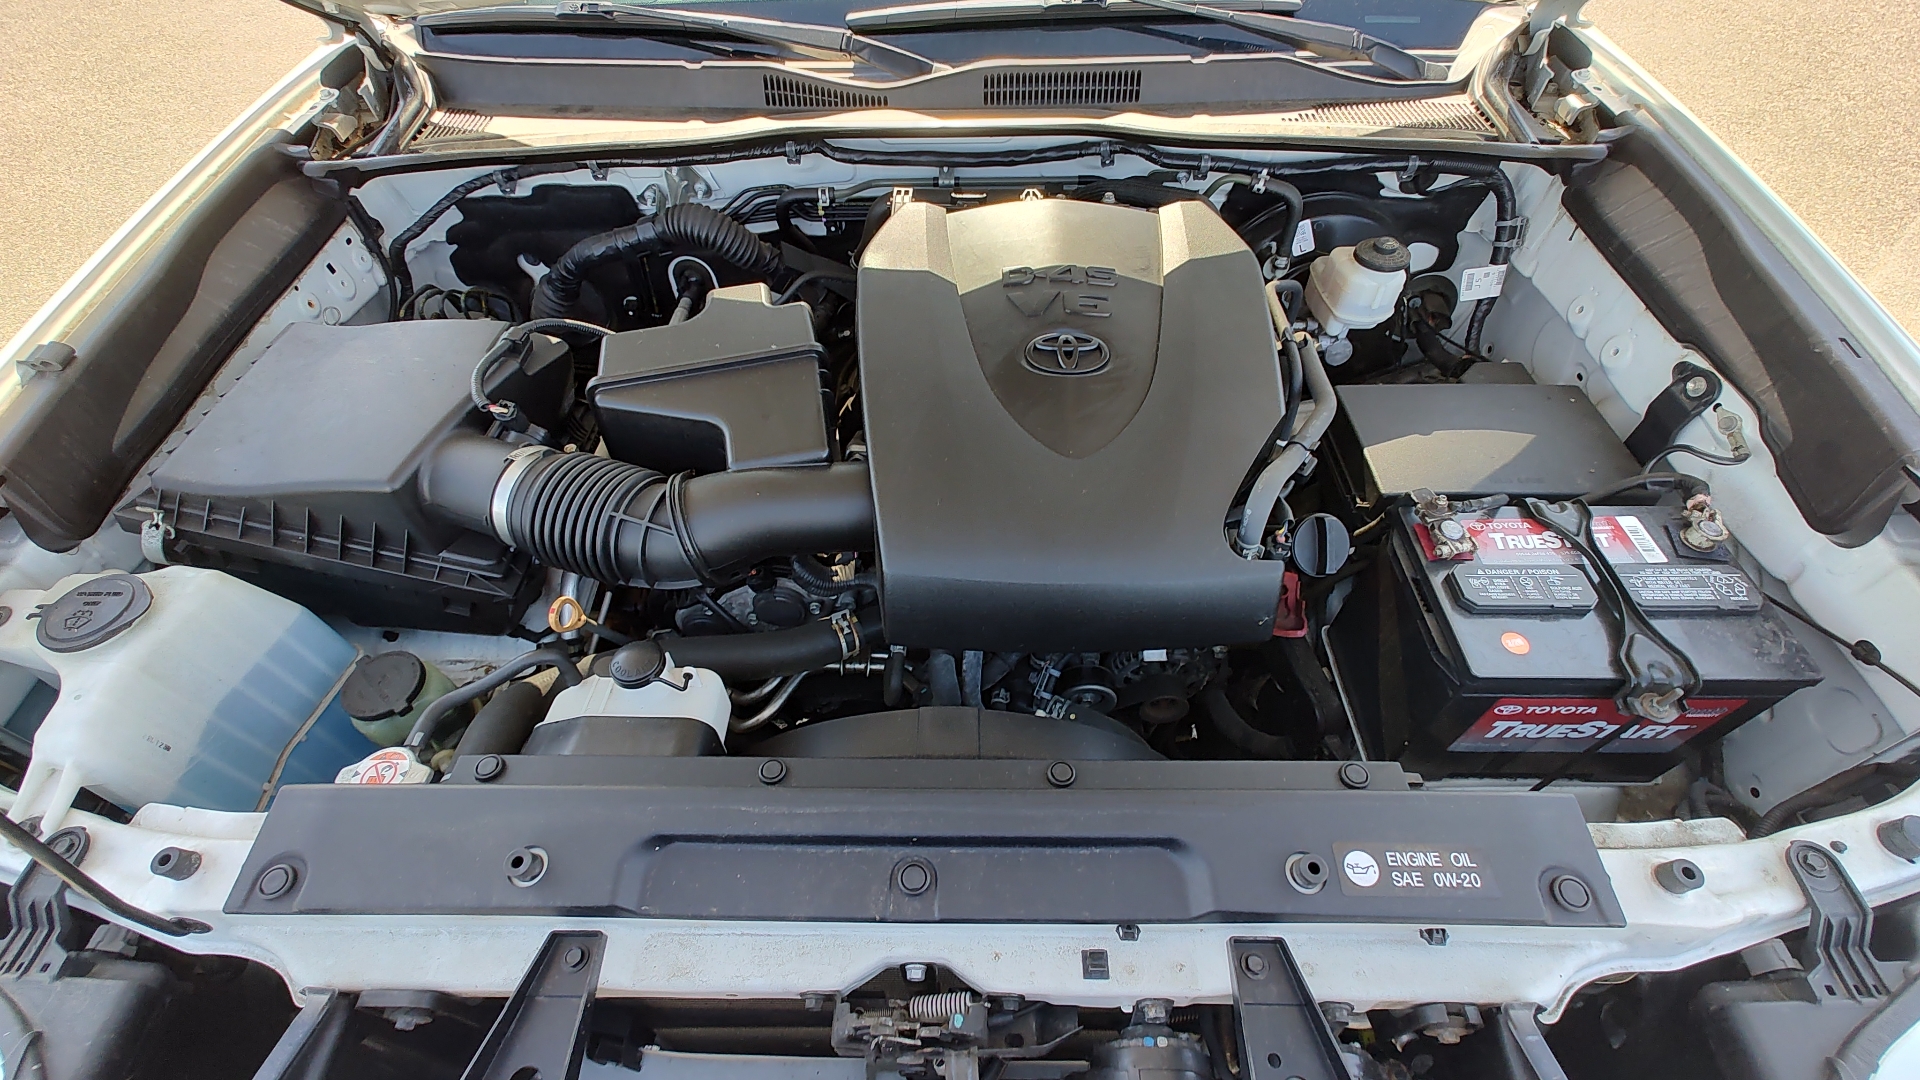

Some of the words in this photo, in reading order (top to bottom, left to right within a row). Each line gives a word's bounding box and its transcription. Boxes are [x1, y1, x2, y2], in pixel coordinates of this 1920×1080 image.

[1002, 265, 1118, 288] D-4S
[1484, 521, 1533, 530] TOYOTA
[1525, 706, 1598, 715] TOYOTA
[1385, 852, 1443, 868] ENGINE
[1450, 852, 1478, 868] OIL
[1391, 872, 1425, 888] SAE
[1433, 873, 1482, 888] 0W-20
